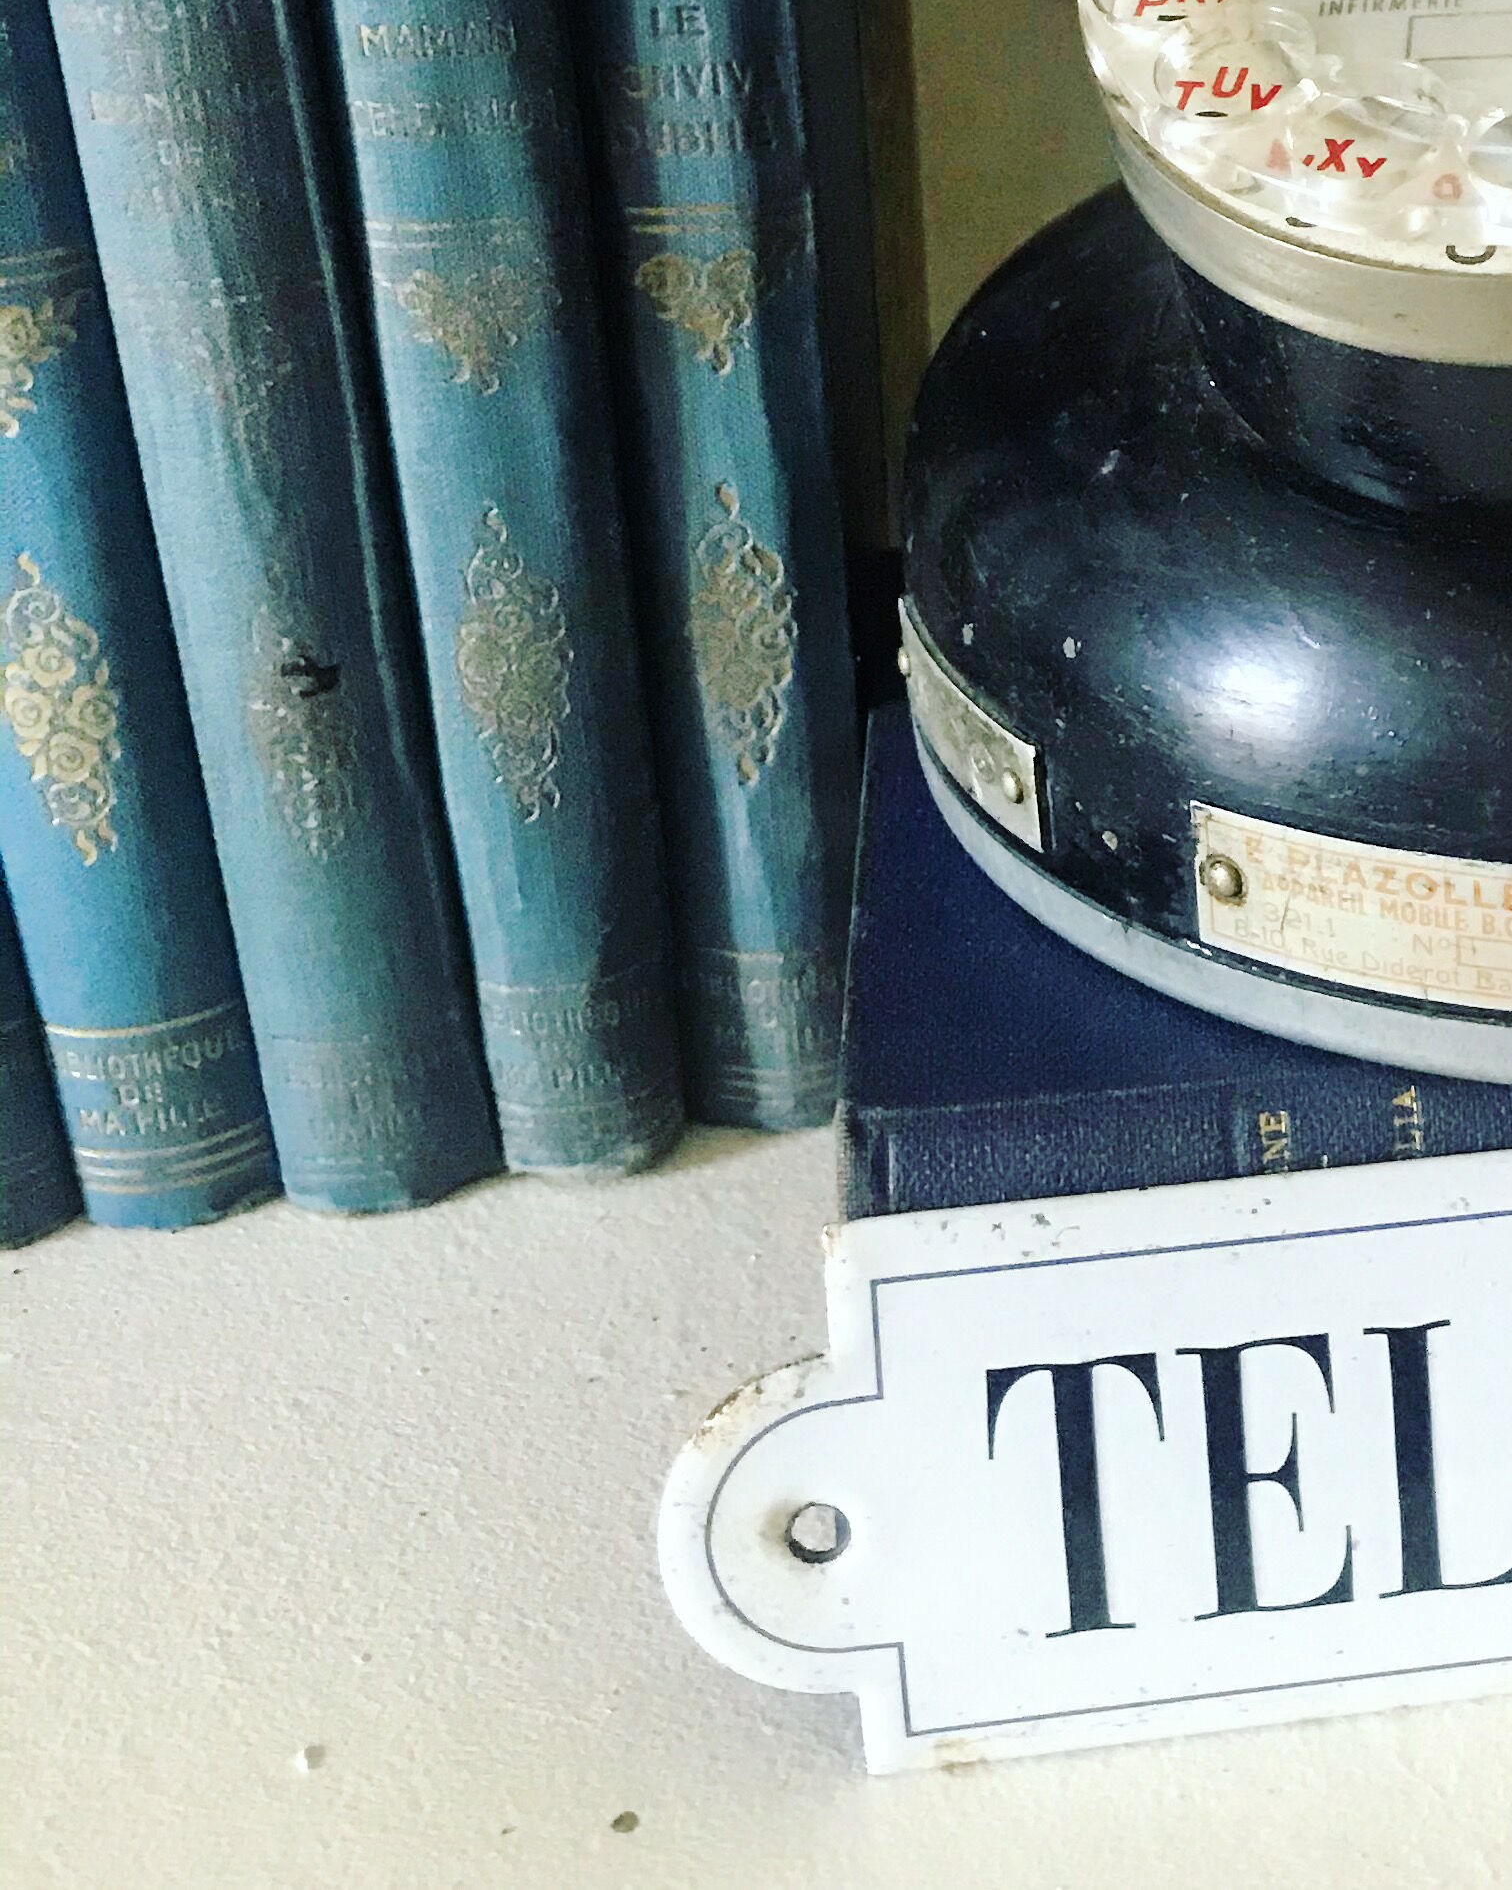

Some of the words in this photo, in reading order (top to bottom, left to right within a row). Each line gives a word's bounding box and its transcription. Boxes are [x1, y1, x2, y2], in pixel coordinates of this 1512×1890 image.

[1379, 896, 1470, 932] MOBILE
[1302, 936, 1350, 966] Rue
[1361, 950, 1461, 986] Diderot
